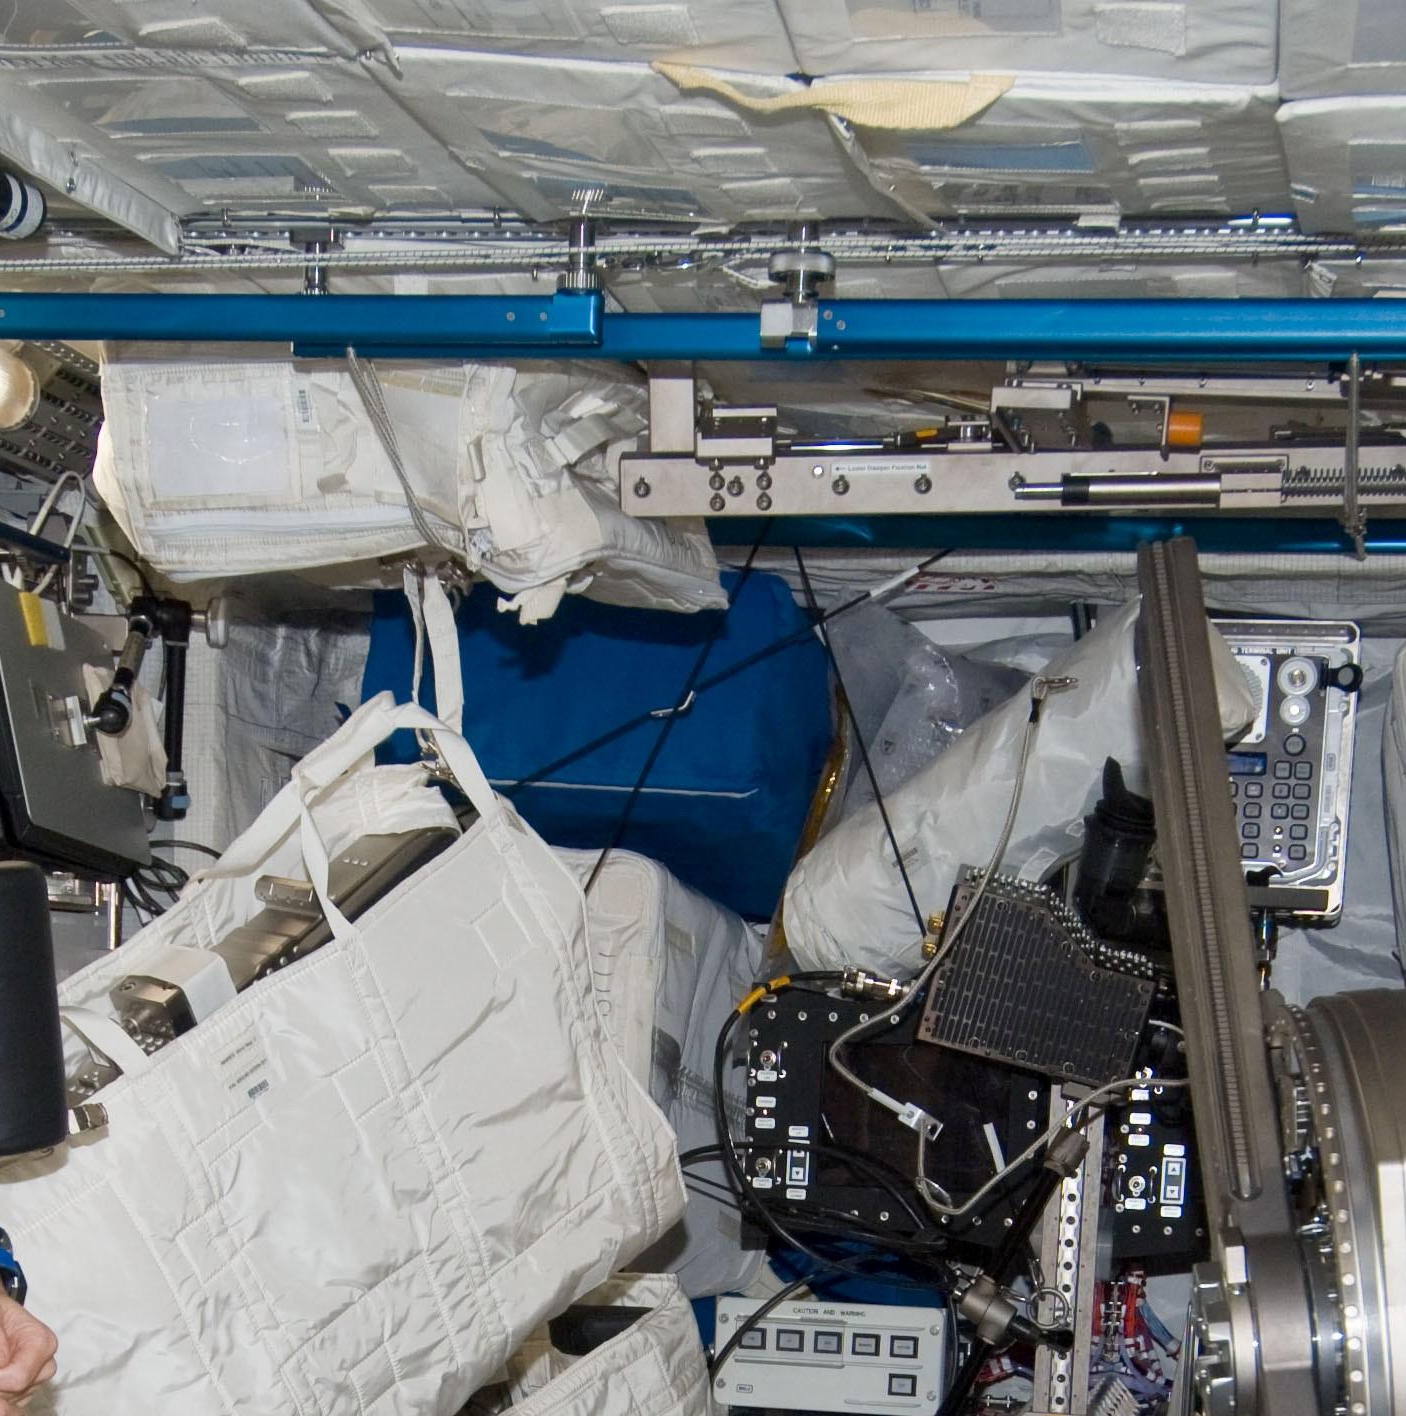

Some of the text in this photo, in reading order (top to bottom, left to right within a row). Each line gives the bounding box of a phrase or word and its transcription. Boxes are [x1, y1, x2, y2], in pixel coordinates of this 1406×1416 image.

[1240, 647, 1273, 655] TERMINAL
[1276, 647, 1292, 655] UNIT
[793, 1307, 867, 1318] CAUTION AND WARNING
